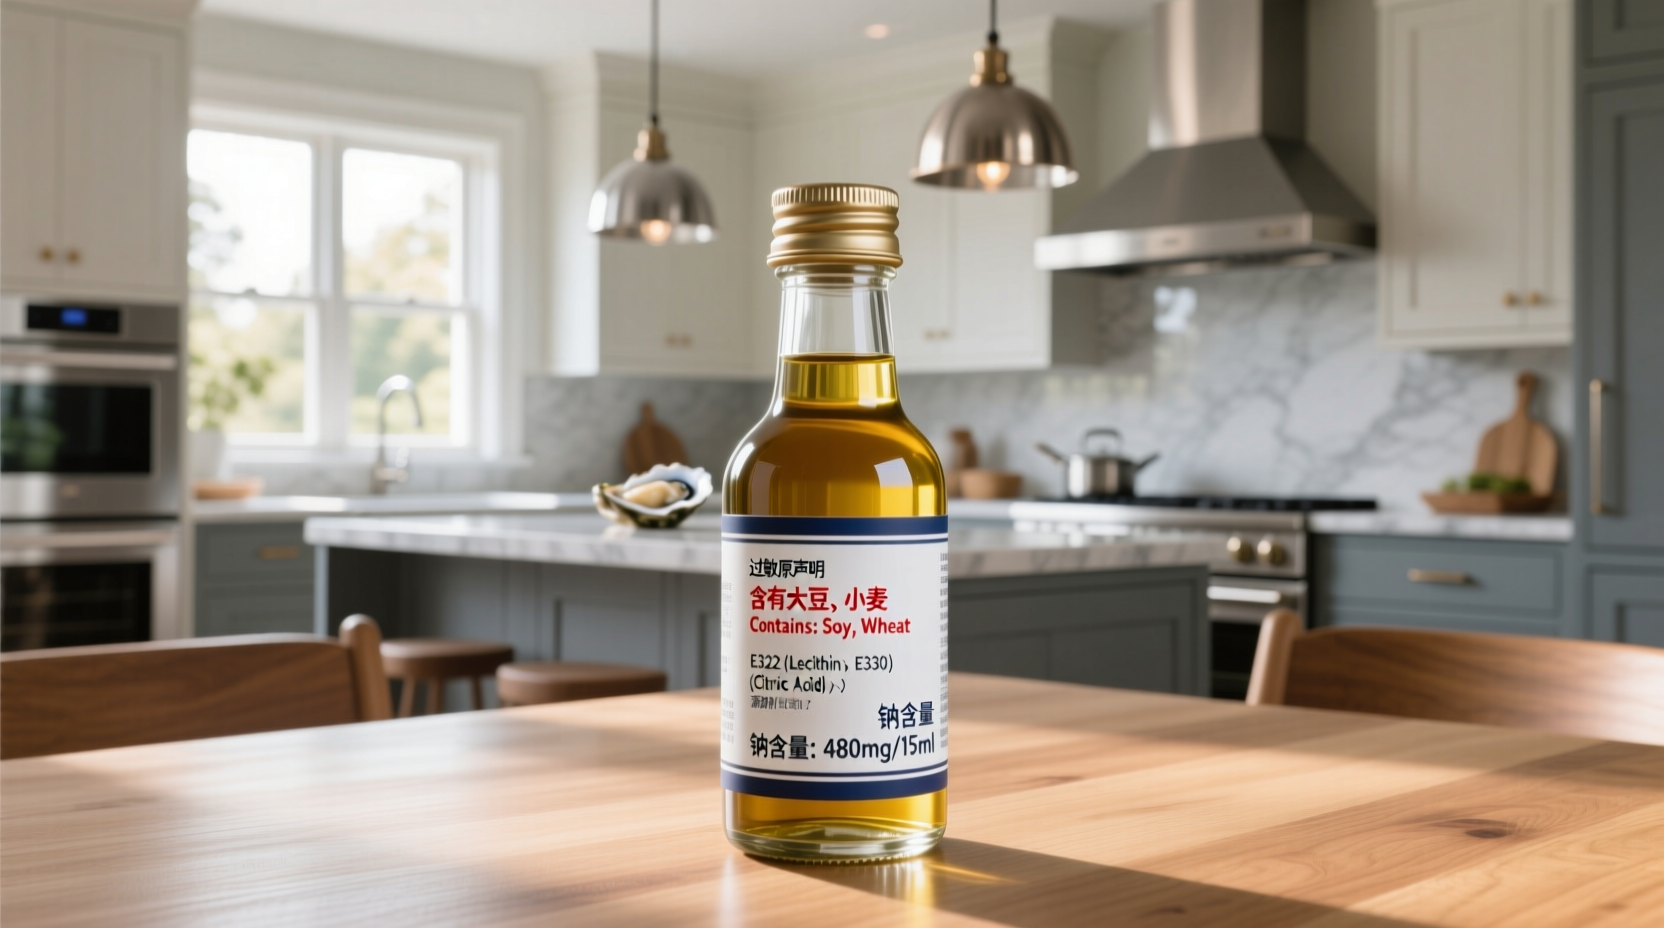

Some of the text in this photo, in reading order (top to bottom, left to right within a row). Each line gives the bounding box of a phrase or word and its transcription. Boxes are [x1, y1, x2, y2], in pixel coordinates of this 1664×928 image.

[750, 616, 911, 640] Contains: Soy, Wheat
[750, 653, 781, 670] E322
[855, 654, 893, 673] E330)
[878, 701, 935, 730] 钠含量
[823, 731, 935, 764] 480mg/15ml
